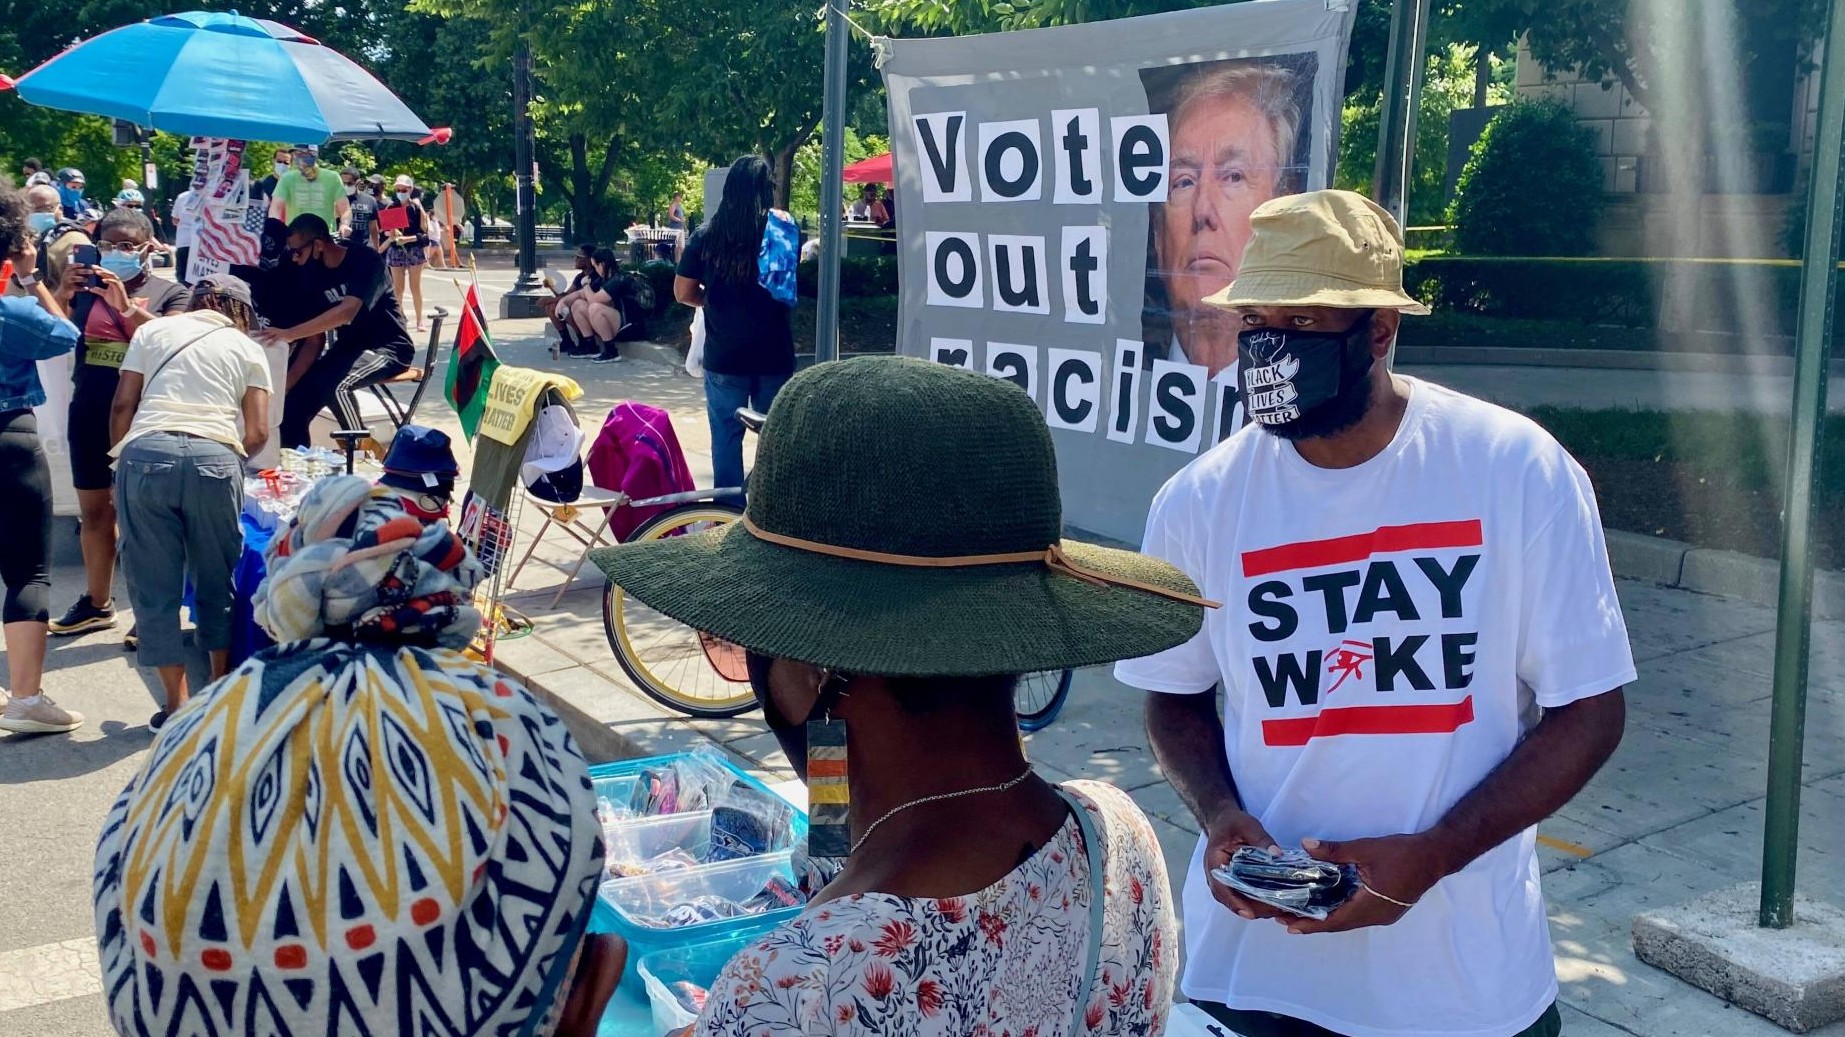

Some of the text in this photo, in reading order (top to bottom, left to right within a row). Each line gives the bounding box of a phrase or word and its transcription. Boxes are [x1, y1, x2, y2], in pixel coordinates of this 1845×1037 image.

[915, 111, 1164, 198] Vote
[933, 236, 1098, 315] out
[937, 347, 1242, 443] racis
[1251, 389, 1285, 409] LIVES
[1252, 411, 1292, 424] ATTER
[1247, 554, 1481, 643] STAY
